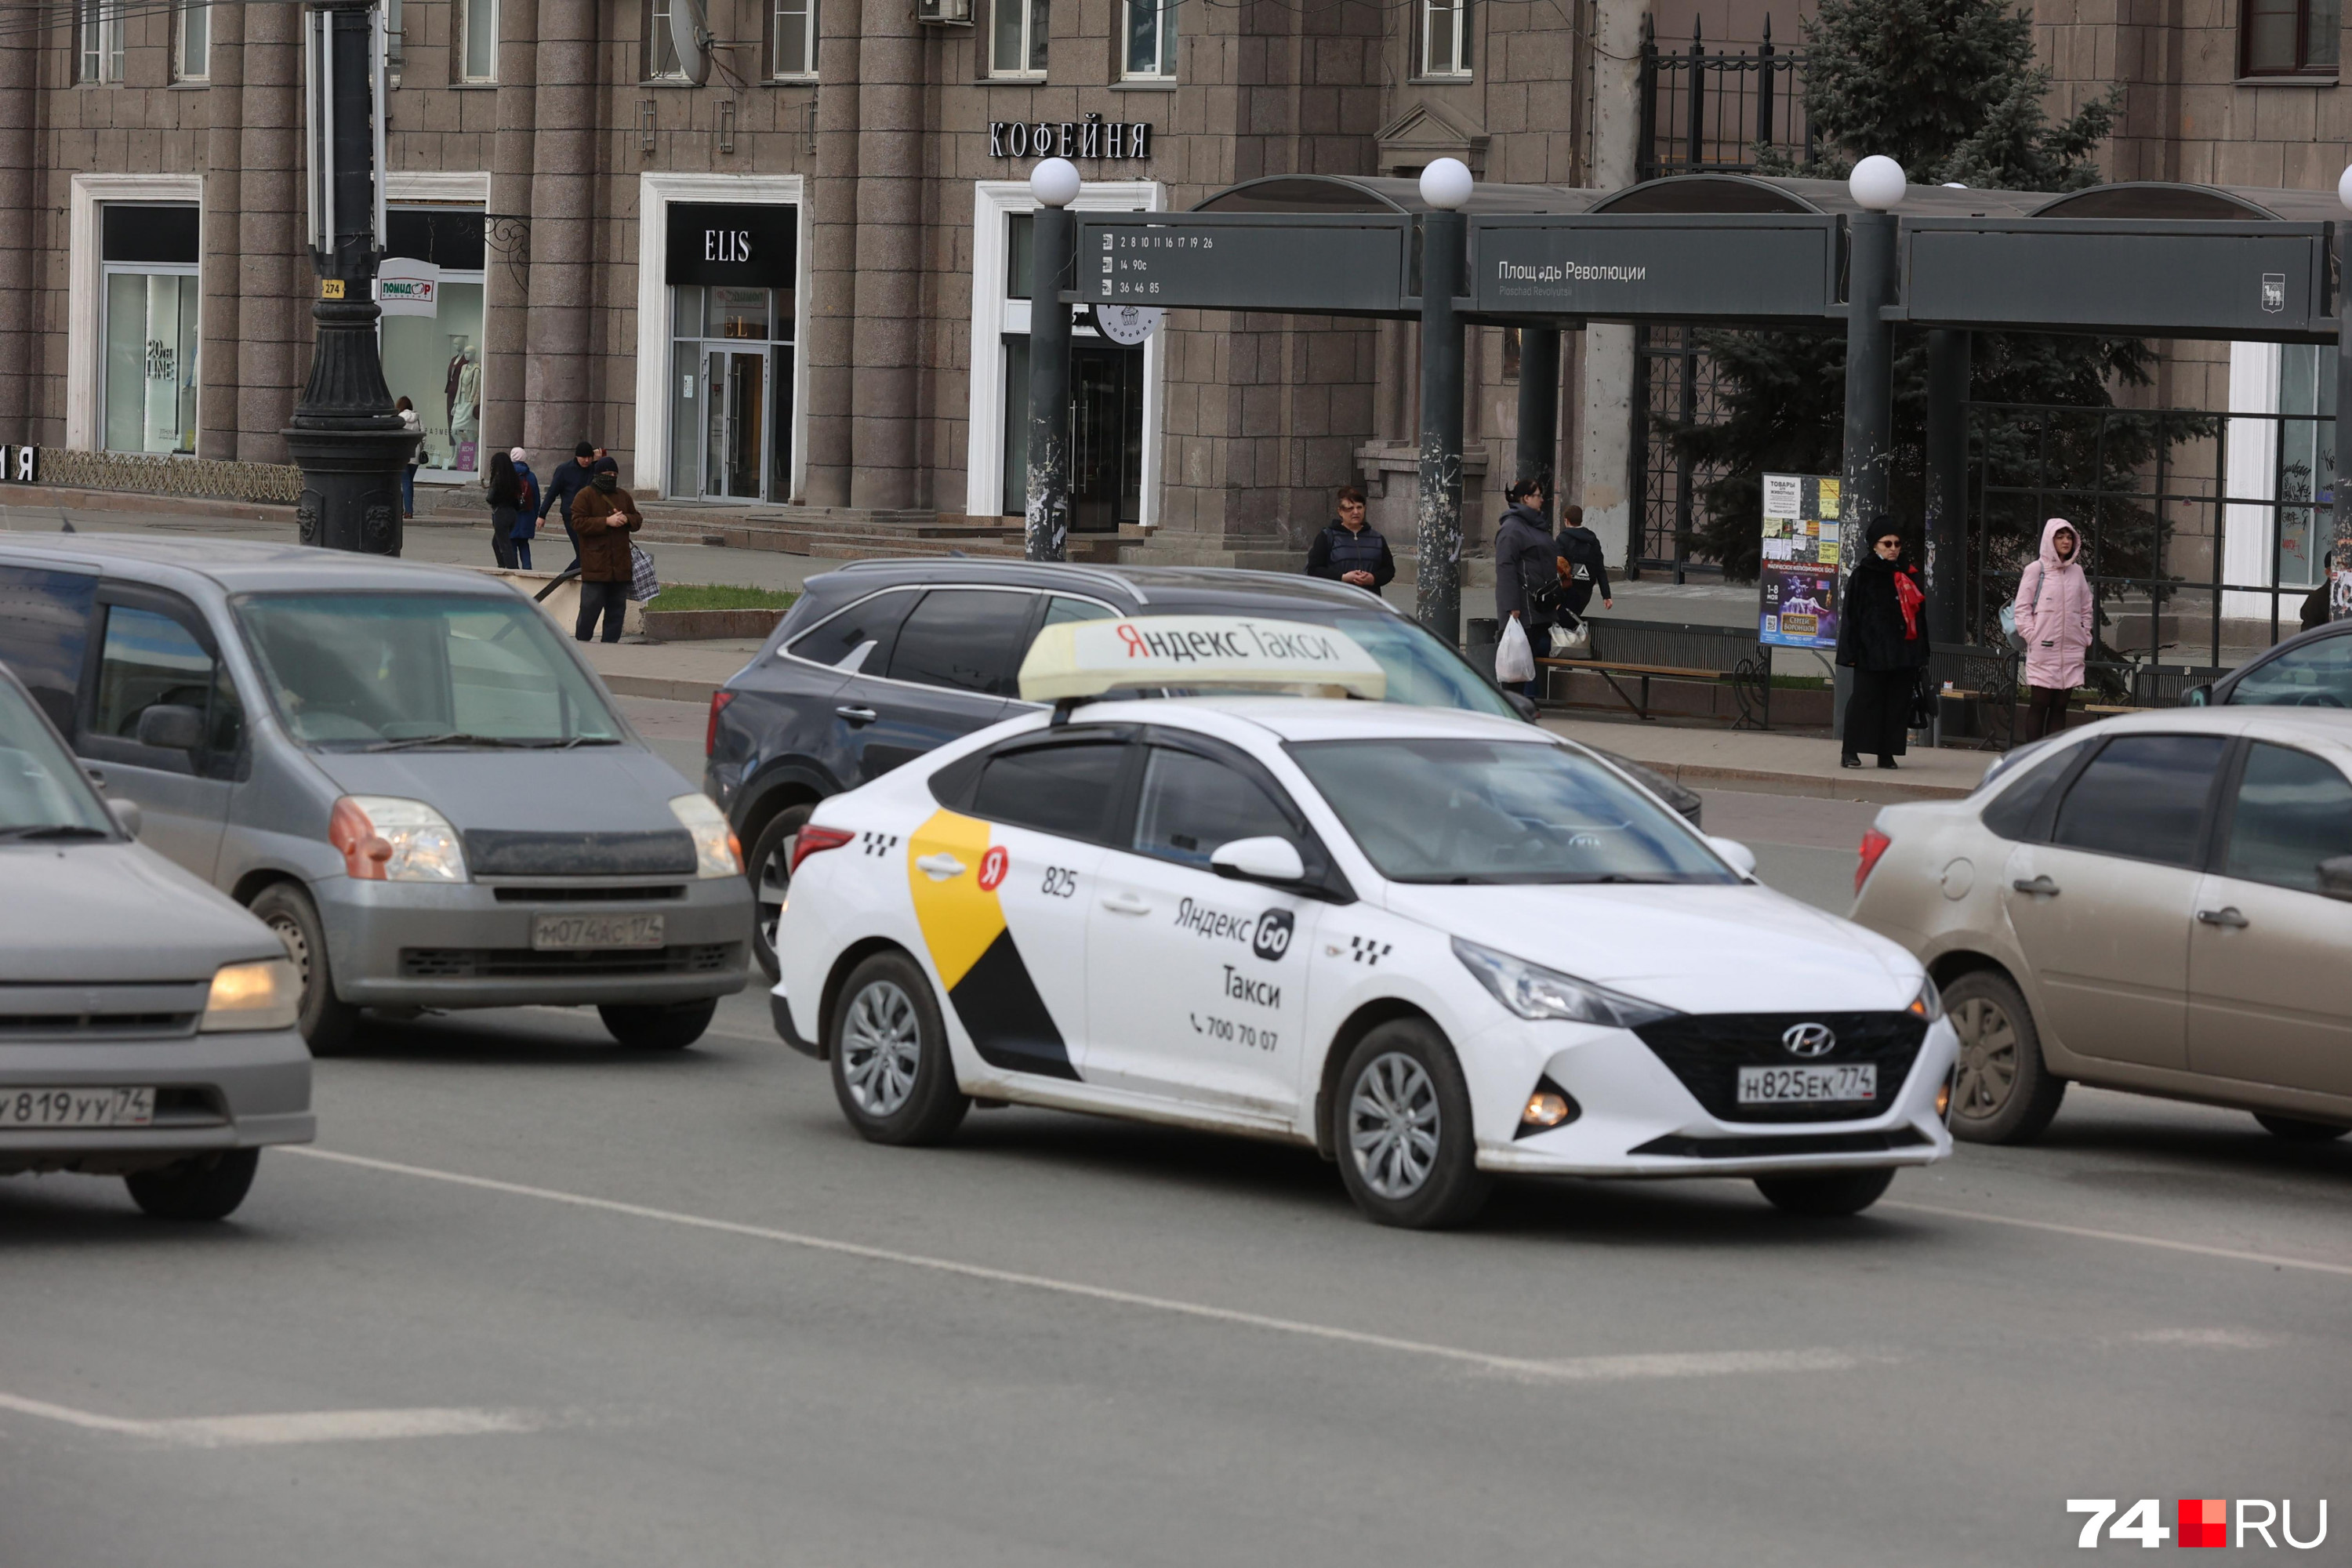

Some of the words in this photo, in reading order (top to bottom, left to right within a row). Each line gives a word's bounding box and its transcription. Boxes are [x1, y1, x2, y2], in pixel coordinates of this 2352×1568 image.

[988, 112, 1148, 158] КОФЕЙНЯ
[705, 230, 750, 263] ELIS
[1120, 237, 1126, 248] 2
[1131, 237, 1136, 248] 8
[1141, 237, 1149, 248] 10
[1154, 237, 1160, 248] 11
[1165, 237, 1174, 248] 16
[1178, 237, 1185, 248] 17
[1190, 237, 1198, 249] 19
[1203, 238, 1213, 249] 26
[1120, 260, 1128, 270] 14
[1498, 261, 1562, 282] Площадь
[1566, 261, 1646, 283] Революции
[325, 284, 339, 294] 274
[1120, 281, 1130, 293] 36
[1134, 282, 1144, 293] 46
[1149, 282, 1160, 294] 85
[1107, 319, 1152, 338] кофейня
[1116, 624, 1249, 662] Яндекс
[1237, 622, 1340, 661] Такси
[980, 851, 1004, 885] Я
[1042, 866, 1079, 899] 825
[1174, 897, 1253, 942] Яндекс
[1255, 915, 1290, 953] Go
[1223, 964, 1281, 1010] Такси
[1207, 1015, 1233, 1041] 700
[1238, 1024, 1256, 1047] 70
[1261, 1030, 1278, 1052] 07
[1745, 1070, 1834, 1099] Н825ЕК
[1838, 1066, 1872, 1089] 774
[118, 1087, 147, 1112] 74
